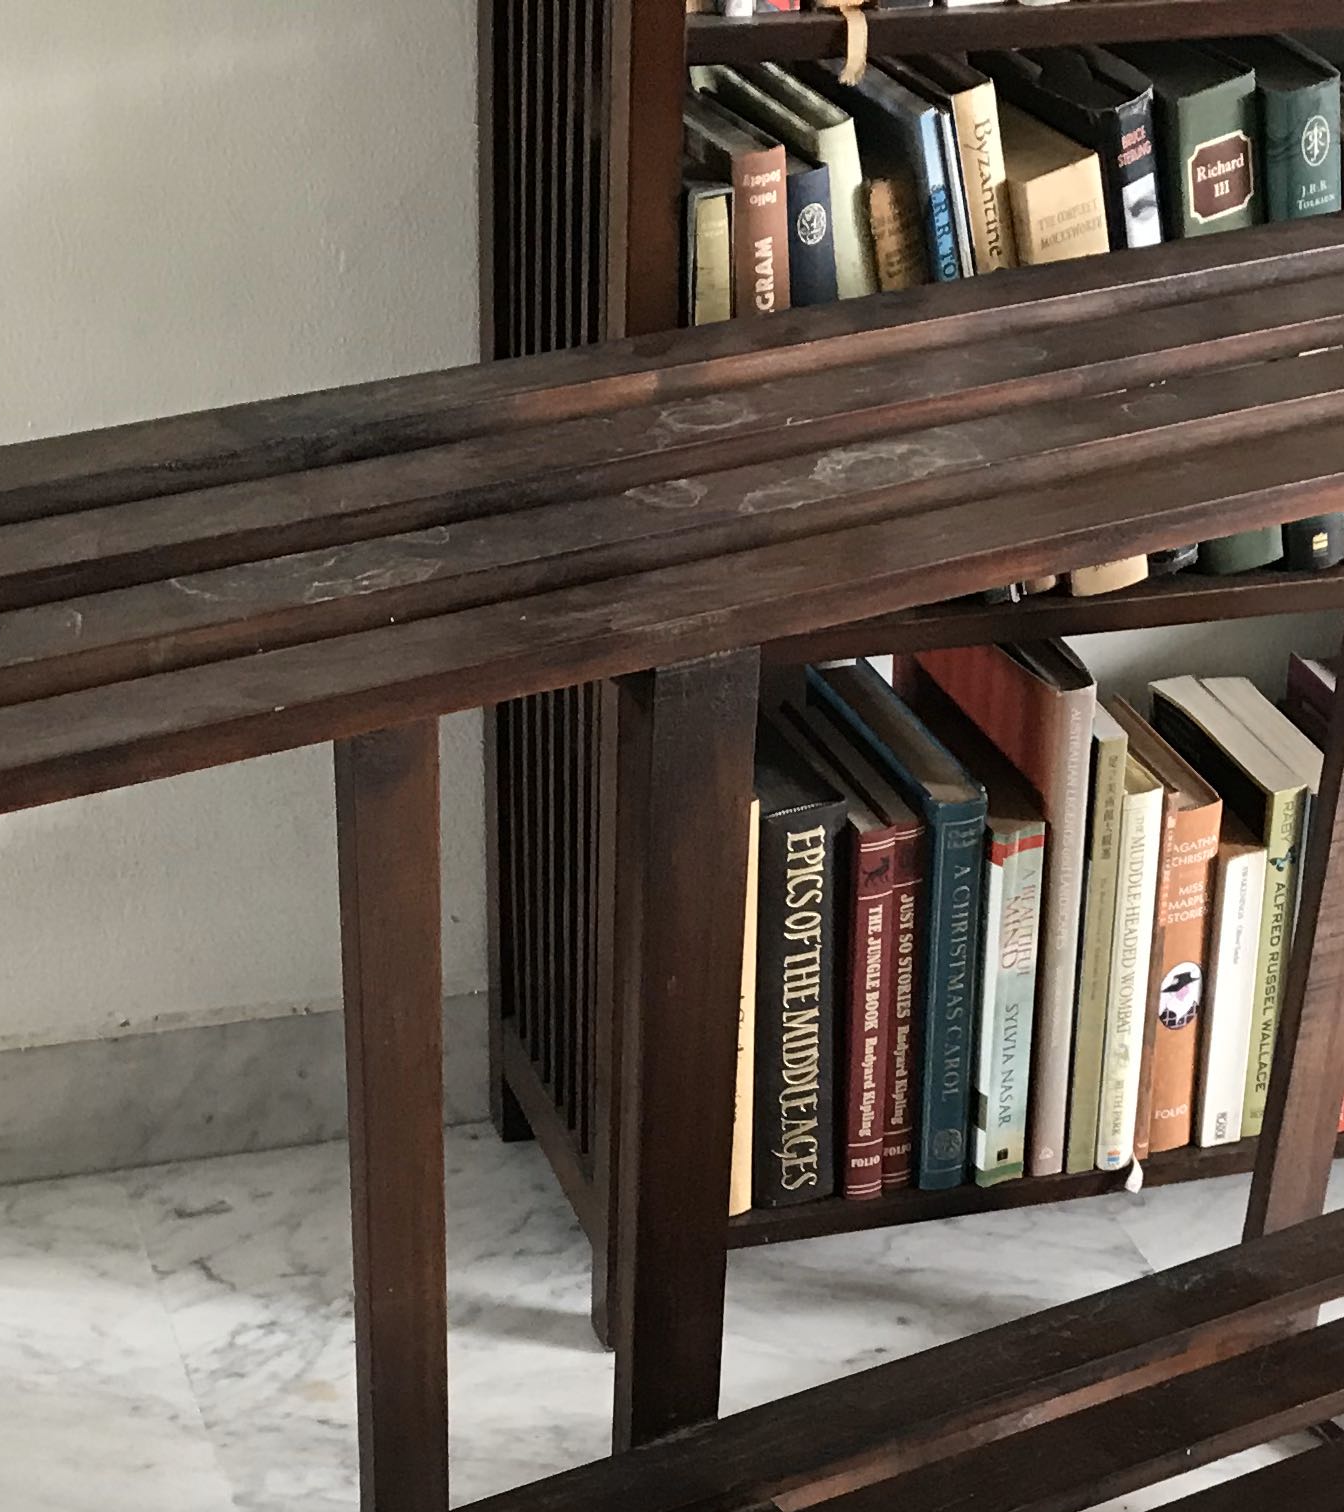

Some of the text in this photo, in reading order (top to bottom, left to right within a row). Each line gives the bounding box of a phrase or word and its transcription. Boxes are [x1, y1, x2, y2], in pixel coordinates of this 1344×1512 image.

[964, 118, 1002, 257] Byzantine
[1196, 153, 1245, 182] Richard
[1213, 180, 1230, 198] III
[1280, 801, 1295, 843] RABY
[1121, 834, 1146, 968] MUDDLE-HEADED
[1178, 881, 1204, 896] MISS
[1269, 882, 1286, 947] ALFRED
[1002, 896, 1021, 969] MIND
[771, 825, 826, 1190] EPICS OF THE MIDDLE AGES
[891, 893, 915, 1125] JUST SO STORIES Rudyard Kipling
[942, 865, 971, 1102] A CHRISTMAS CAROL
[1116, 971, 1135, 1036] WOMBAT
[1263, 952, 1280, 1015] RUSSEL
[858, 904, 883, 1137] THE JUNGLE BOOK Rudyard Kipling
[1256, 1018, 1273, 1092] WALLACE
[998, 1003, 1019, 1128] SYLVIA NASAR
[1155, 1103, 1188, 1120] FOLIO
[851, 1155, 880, 1168] FOLIO
